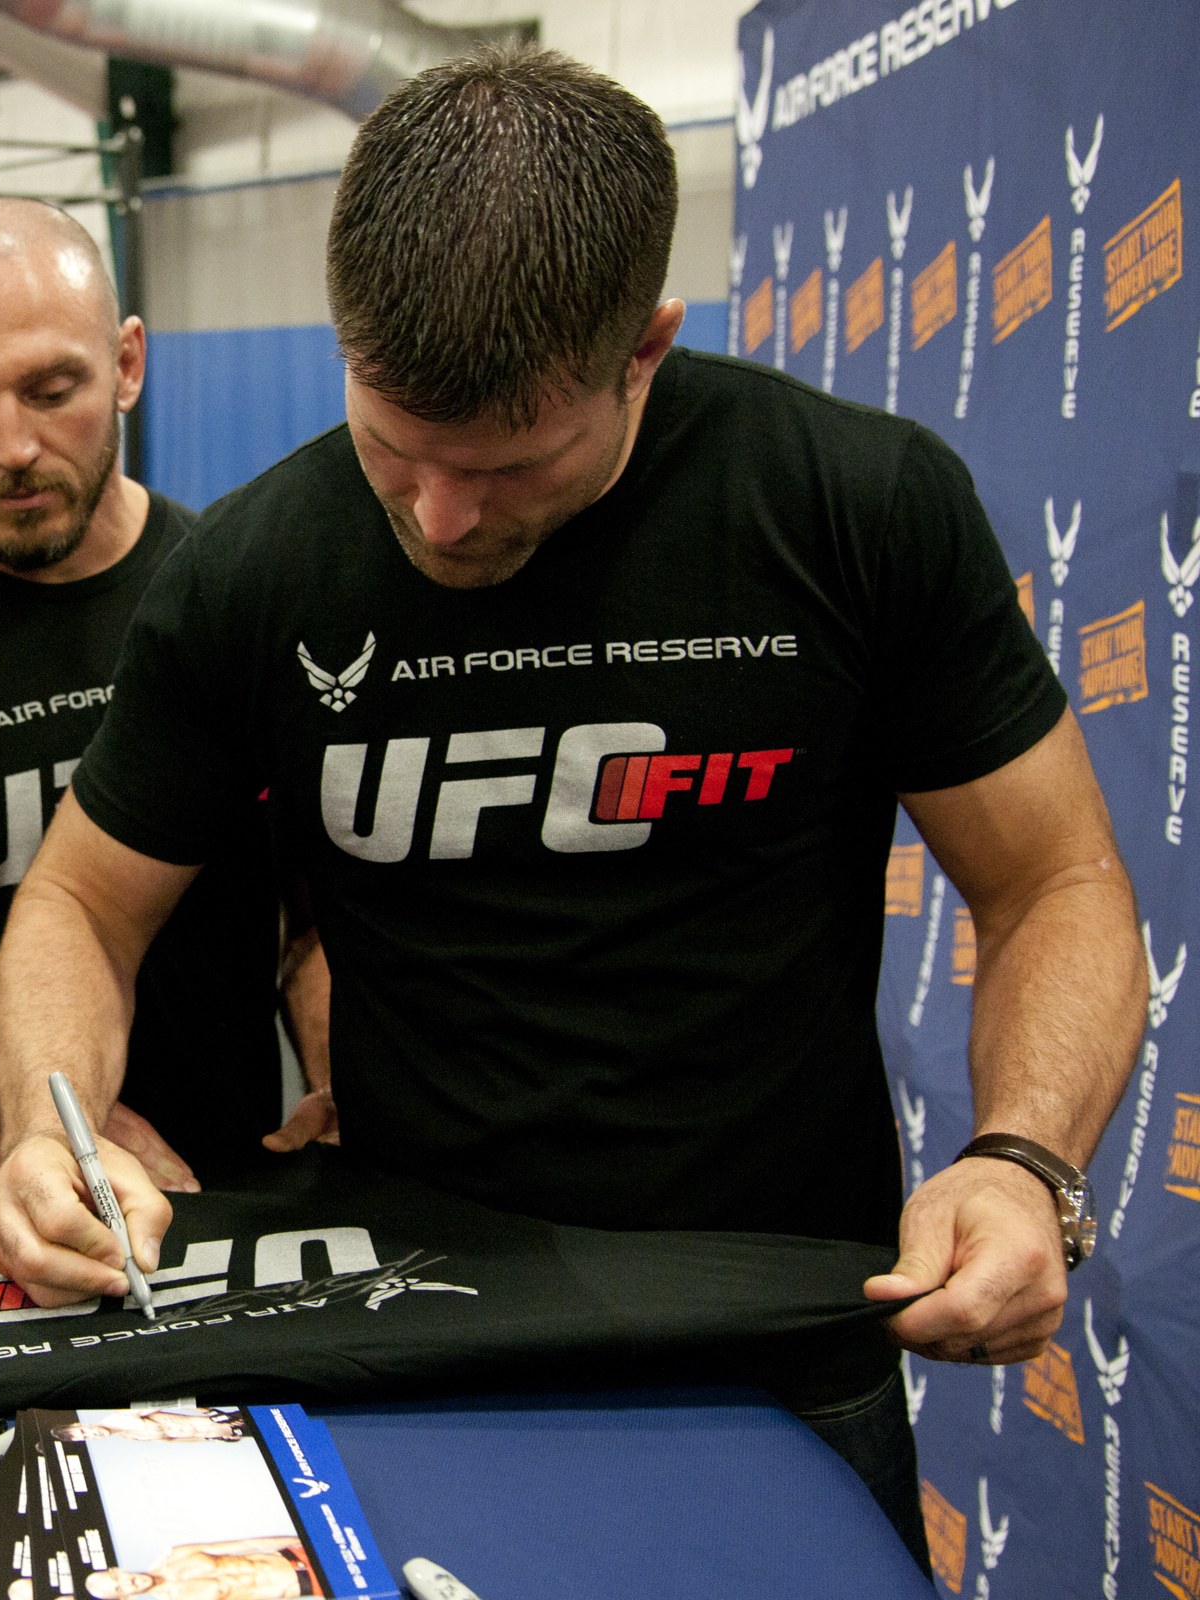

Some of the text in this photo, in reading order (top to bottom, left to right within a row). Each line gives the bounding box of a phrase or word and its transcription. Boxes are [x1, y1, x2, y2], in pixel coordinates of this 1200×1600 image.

[808, 31, 878, 115] FORCE
[879, 0, 1018, 78] RESER
[1061, 228, 1086, 419] RESERVE
[49, 683, 116, 714] FOR
[391, 634, 799, 681] AIR FORCE RESERVE
[319, 722, 795, 863] UFC FIT
[1165, 632, 1191, 845] RESERVE
[1109, 1040, 1160, 1239] RESERVE
[1172, 1107, 1200, 1145] STA
[69, 1313, 233, 1348] FORCE
[244, 1297, 328, 1319] AIR
[1102, 1413, 1121, 1600] RESERVE
